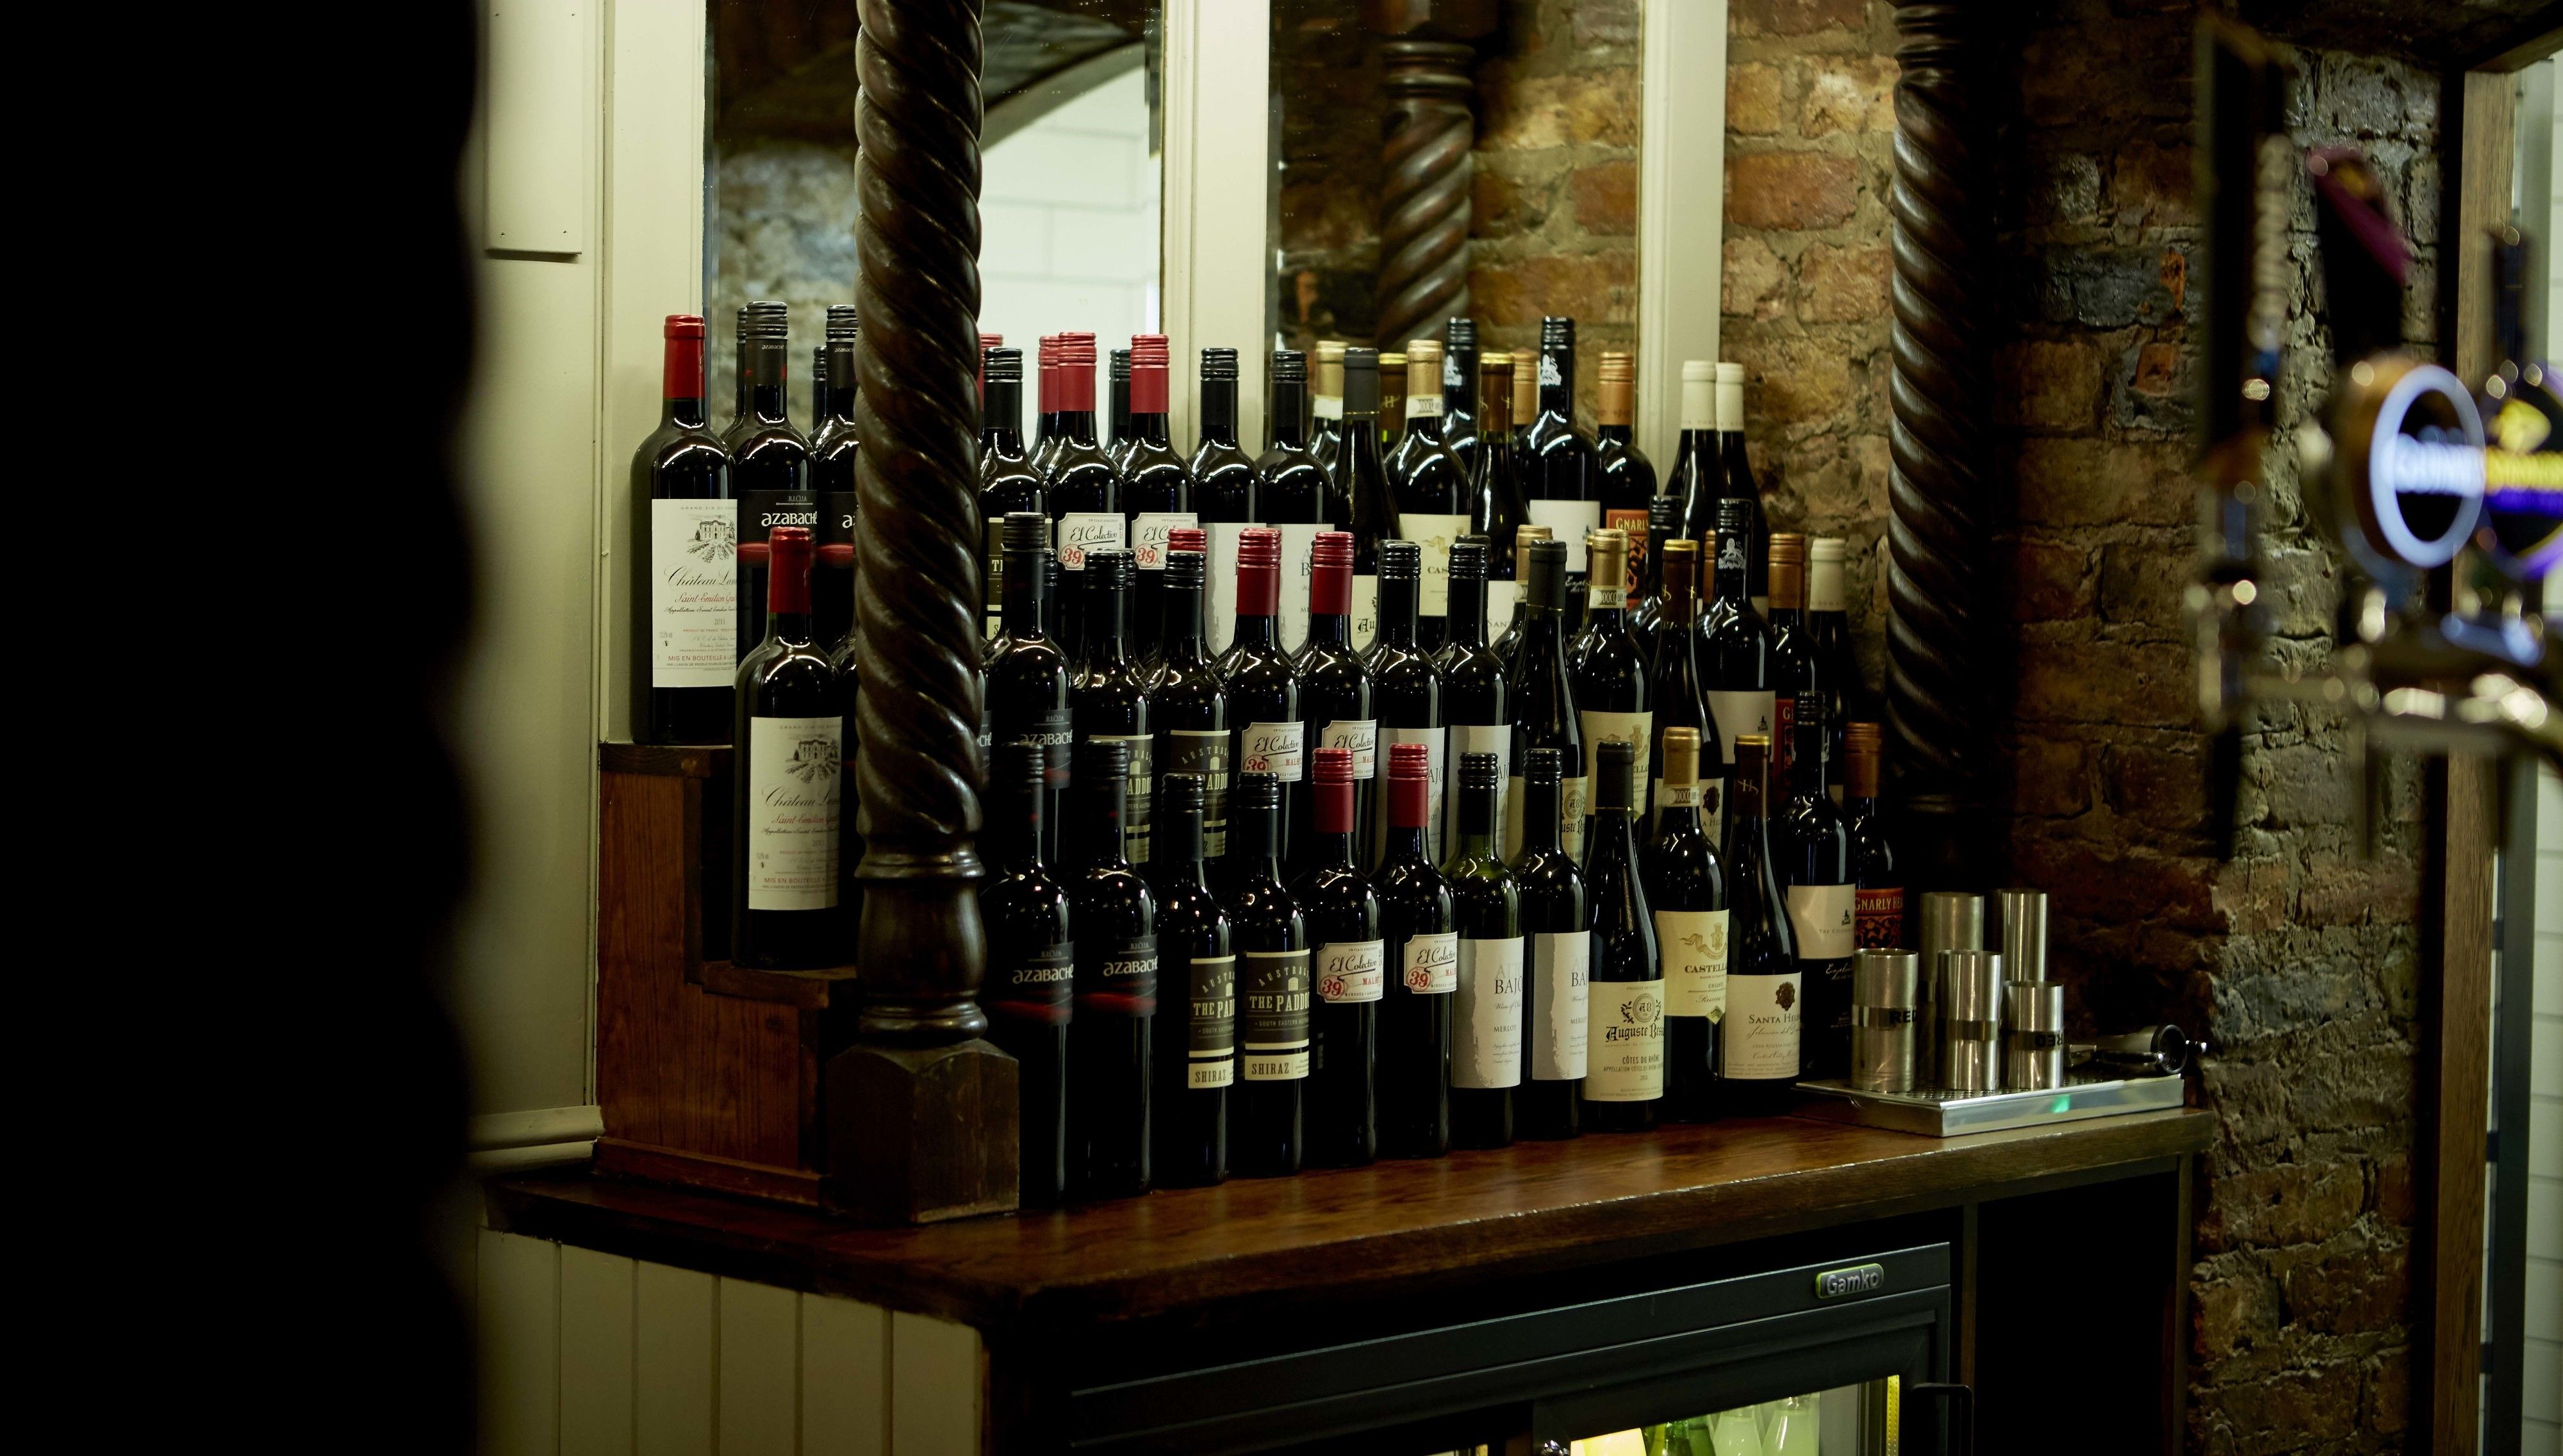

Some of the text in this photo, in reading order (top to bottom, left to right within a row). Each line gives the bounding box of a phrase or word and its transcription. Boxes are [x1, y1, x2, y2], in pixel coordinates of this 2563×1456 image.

[1063, 548, 1082, 564] 39
[1136, 548, 1155, 564] 39
[1330, 956, 1343, 972] El
[1346, 954, 1377, 970] Colectivo
[1417, 949, 1431, 964] El
[1409, 970, 1428, 988] 39
[1322, 979, 1342, 996] 39
[1193, 1001, 1215, 1017] THE
[1250, 995, 1273, 1009] THE
[1749, 1014, 1781, 1024] SANTA
[1494, 1024, 1517, 1033] MERLOT
[1605, 1026, 1648, 1043] Auguste
[1195, 1069, 1226, 1083] SHIRAZ
[1251, 1062, 1289, 1075] SHIRAZ
[1827, 1268, 1879, 1295] Gamko
